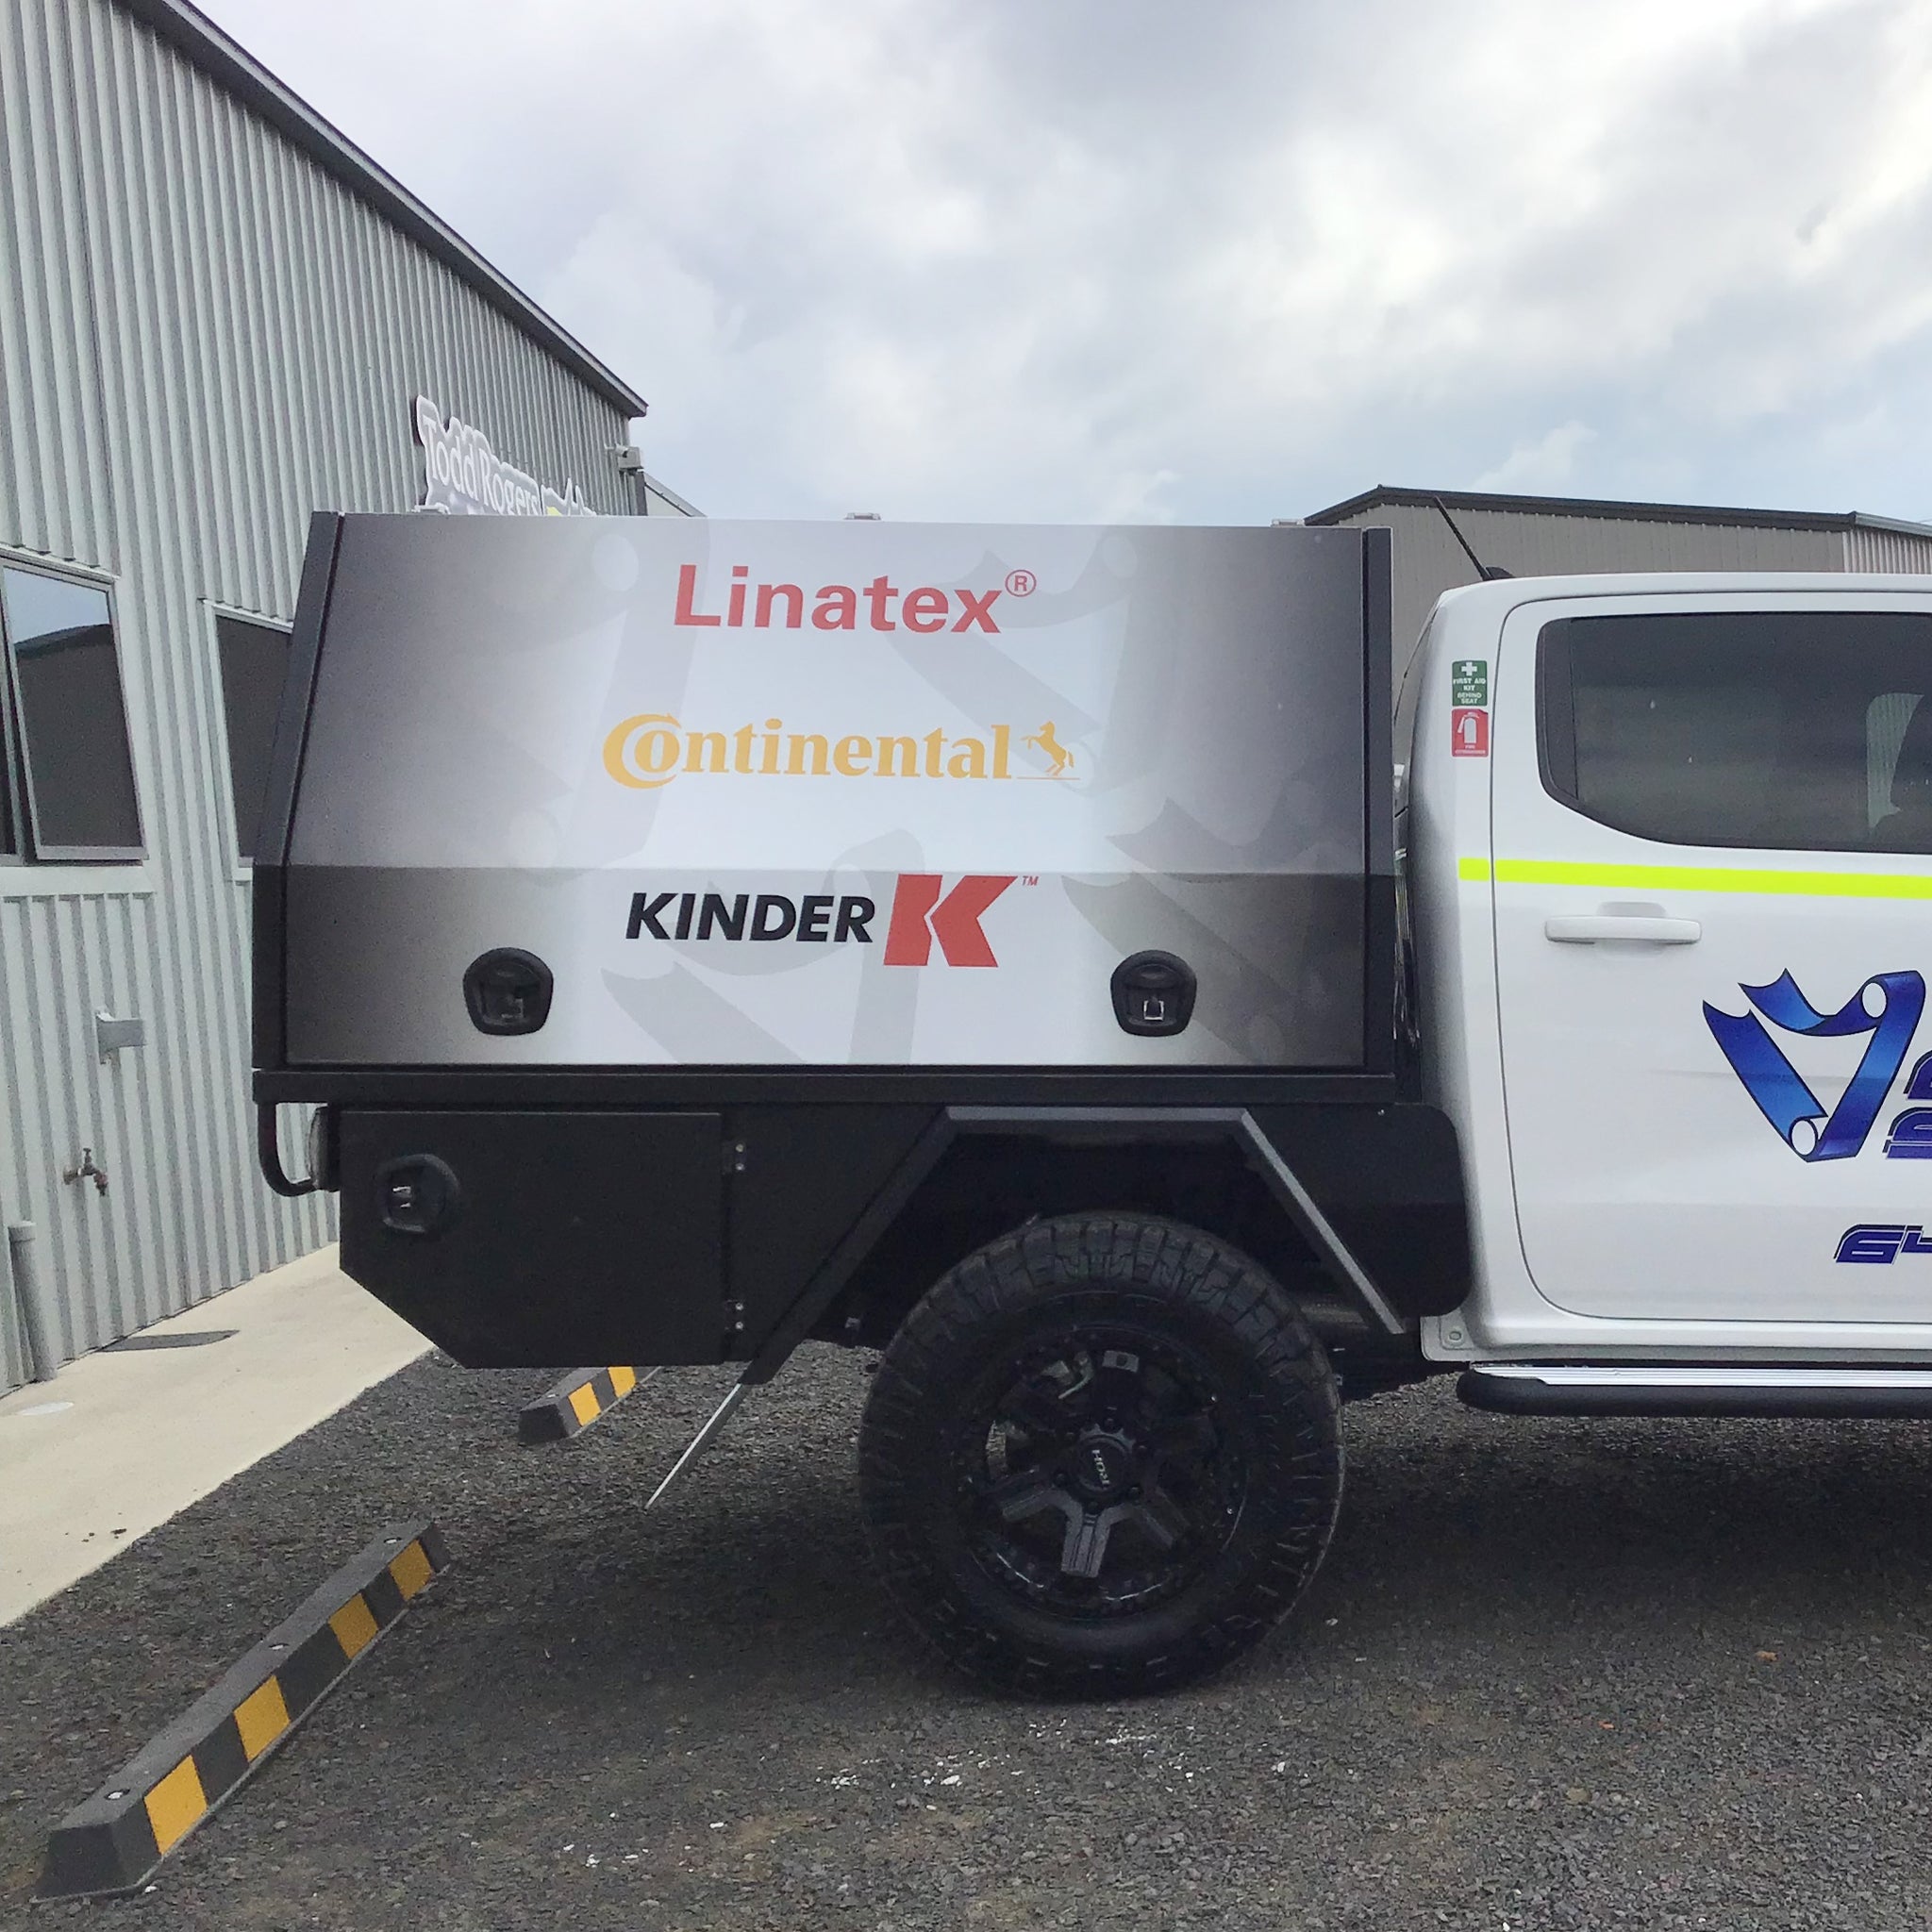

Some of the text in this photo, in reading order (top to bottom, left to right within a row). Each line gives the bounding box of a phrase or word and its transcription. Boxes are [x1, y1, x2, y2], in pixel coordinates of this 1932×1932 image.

[423, 415, 479, 502] Todd
[675, 563, 1002, 634] Linatex
[602, 712, 1012, 790] Continental
[625, 891, 875, 943] KINDER
